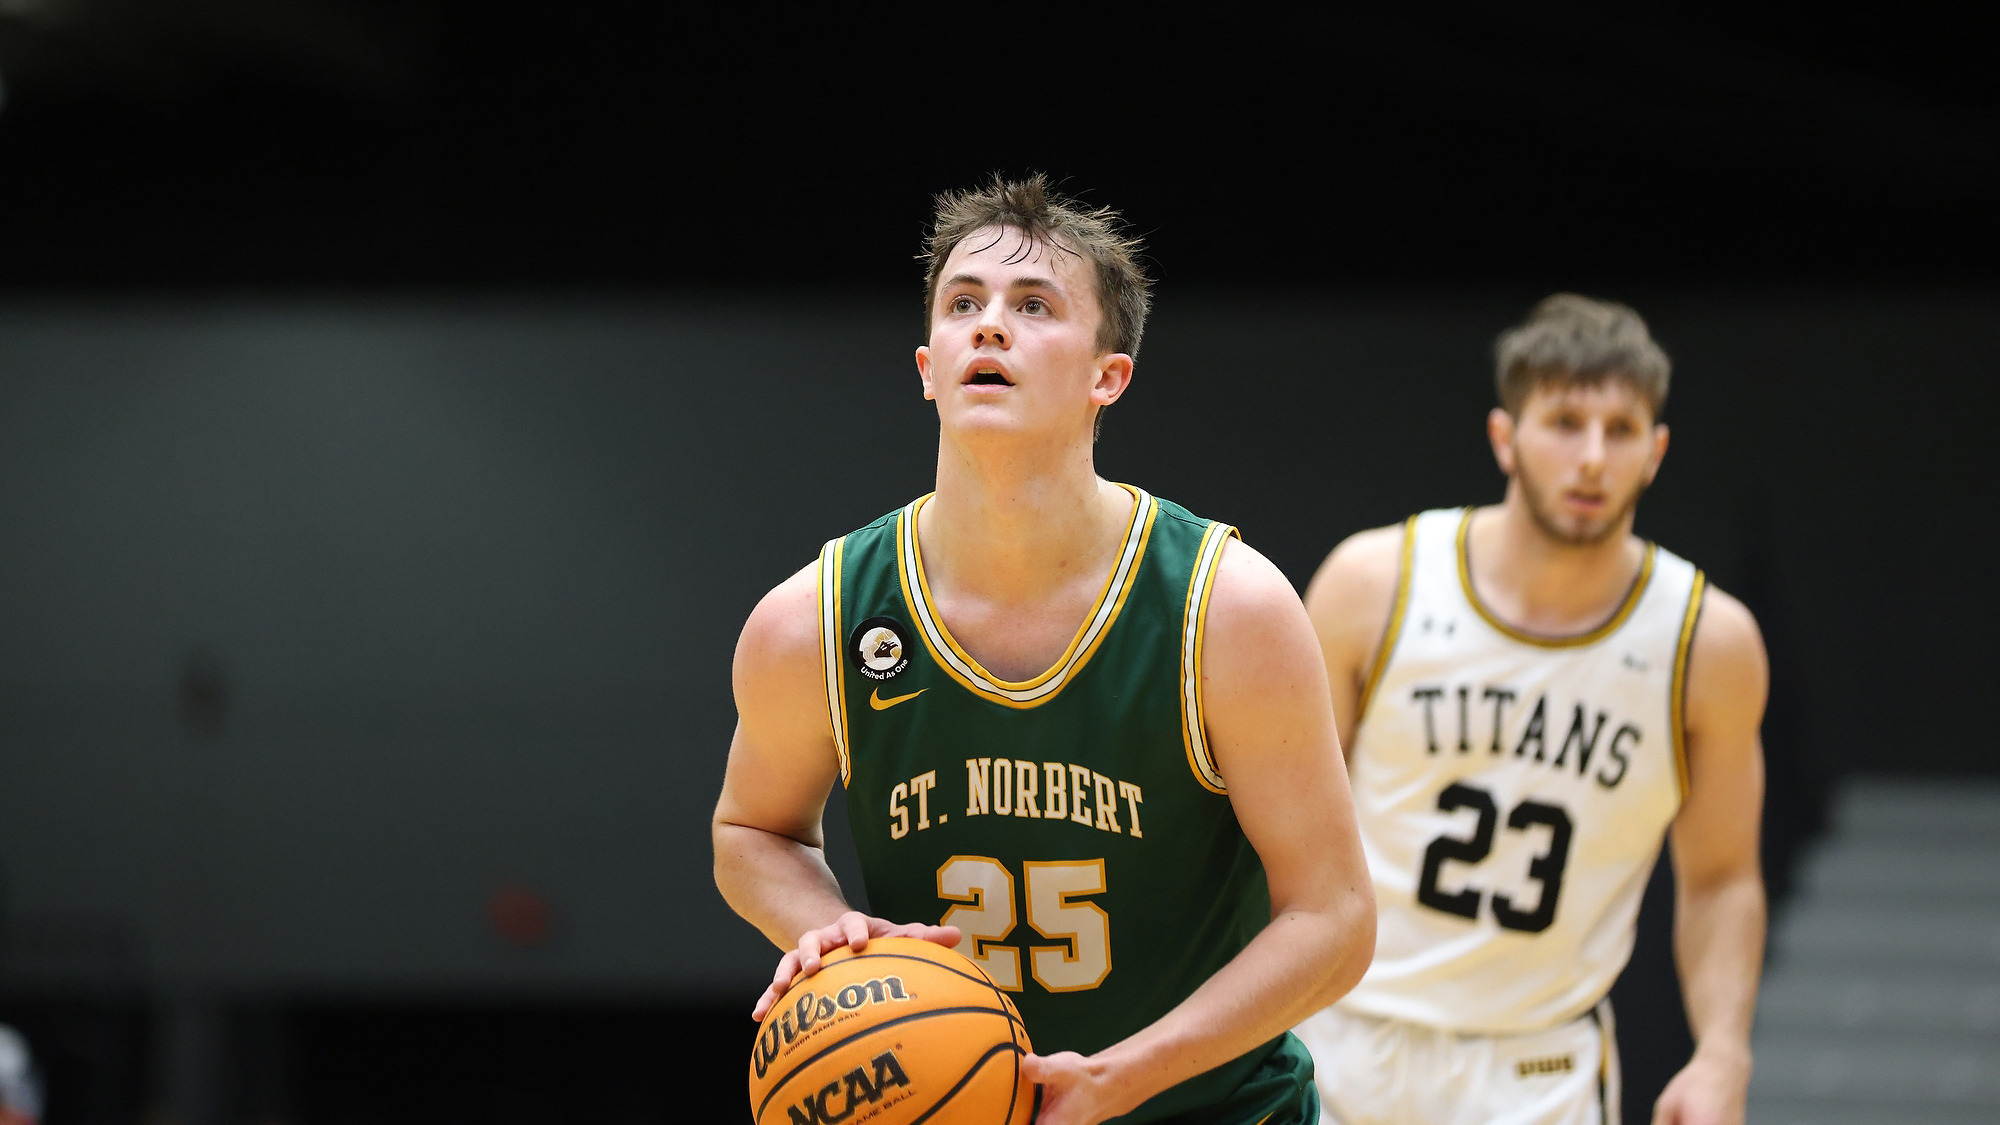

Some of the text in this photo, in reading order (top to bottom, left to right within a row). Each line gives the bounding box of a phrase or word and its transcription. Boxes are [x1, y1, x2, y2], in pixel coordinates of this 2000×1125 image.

[860, 659, 908, 680] United As One
[1411, 686, 1643, 789] TITANS
[889, 757, 1144, 840] ST. NORBERT
[1417, 781, 1575, 933] 23
[936, 854, 1113, 993] 25
[754, 975, 910, 1079] Wilson
[787, 1048, 911, 1125] NCAA
[849, 1090, 917, 1125] AME BALL
